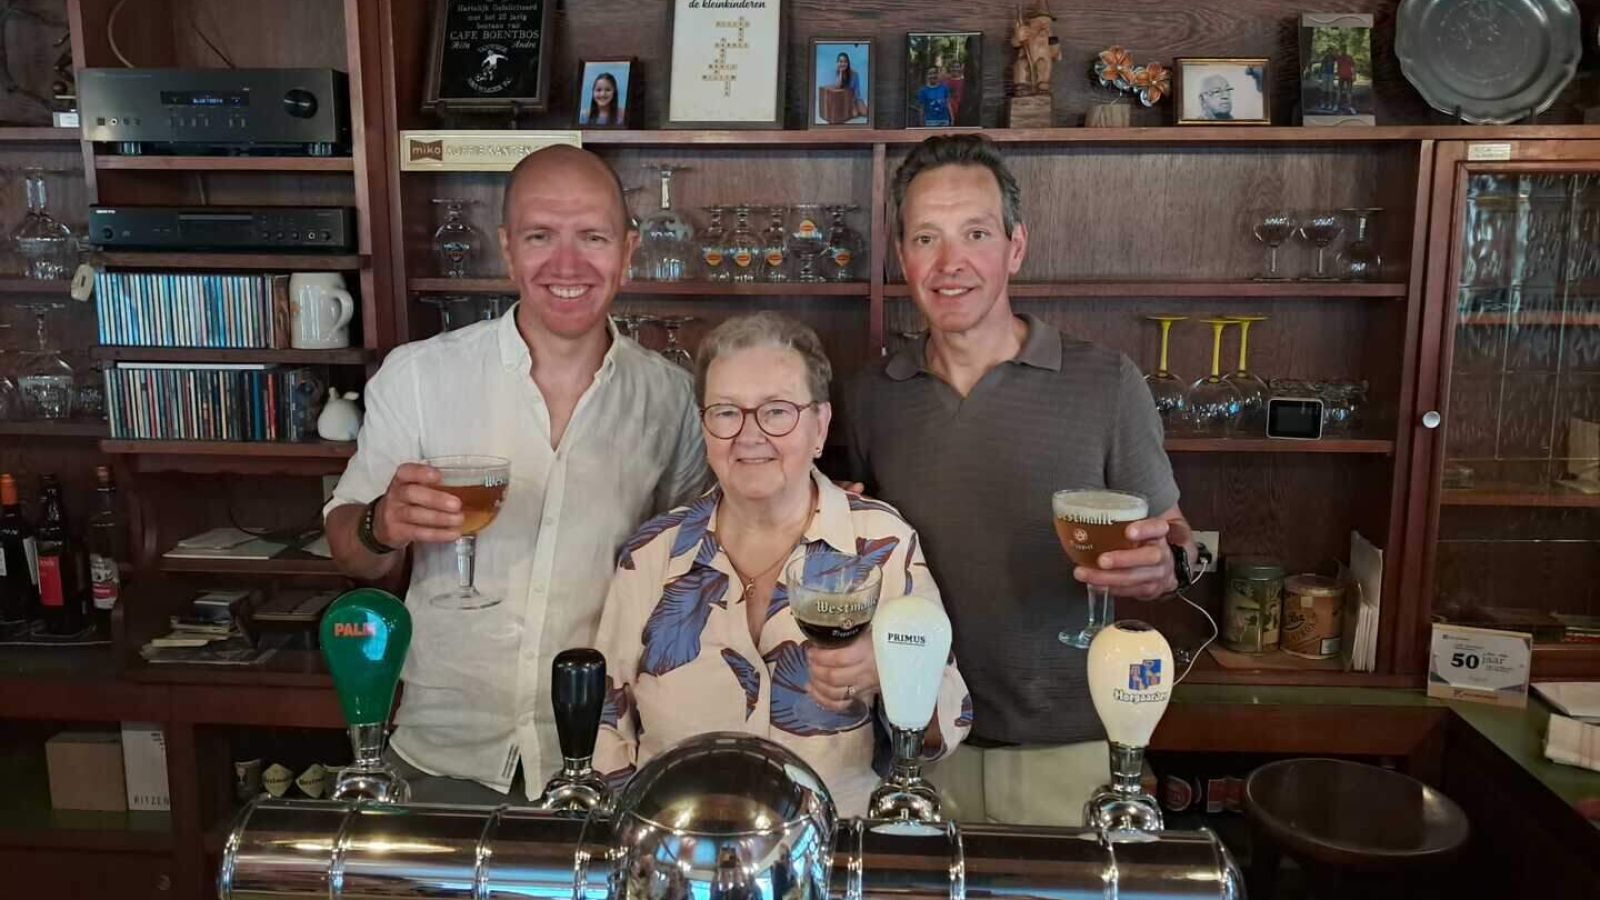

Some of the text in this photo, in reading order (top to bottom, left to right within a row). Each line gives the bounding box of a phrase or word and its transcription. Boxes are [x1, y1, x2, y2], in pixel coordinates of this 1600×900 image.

[412, 145, 441, 155] miko
[887, 631, 926, 644] PRIMUS
[1450, 652, 1480, 669] 50
